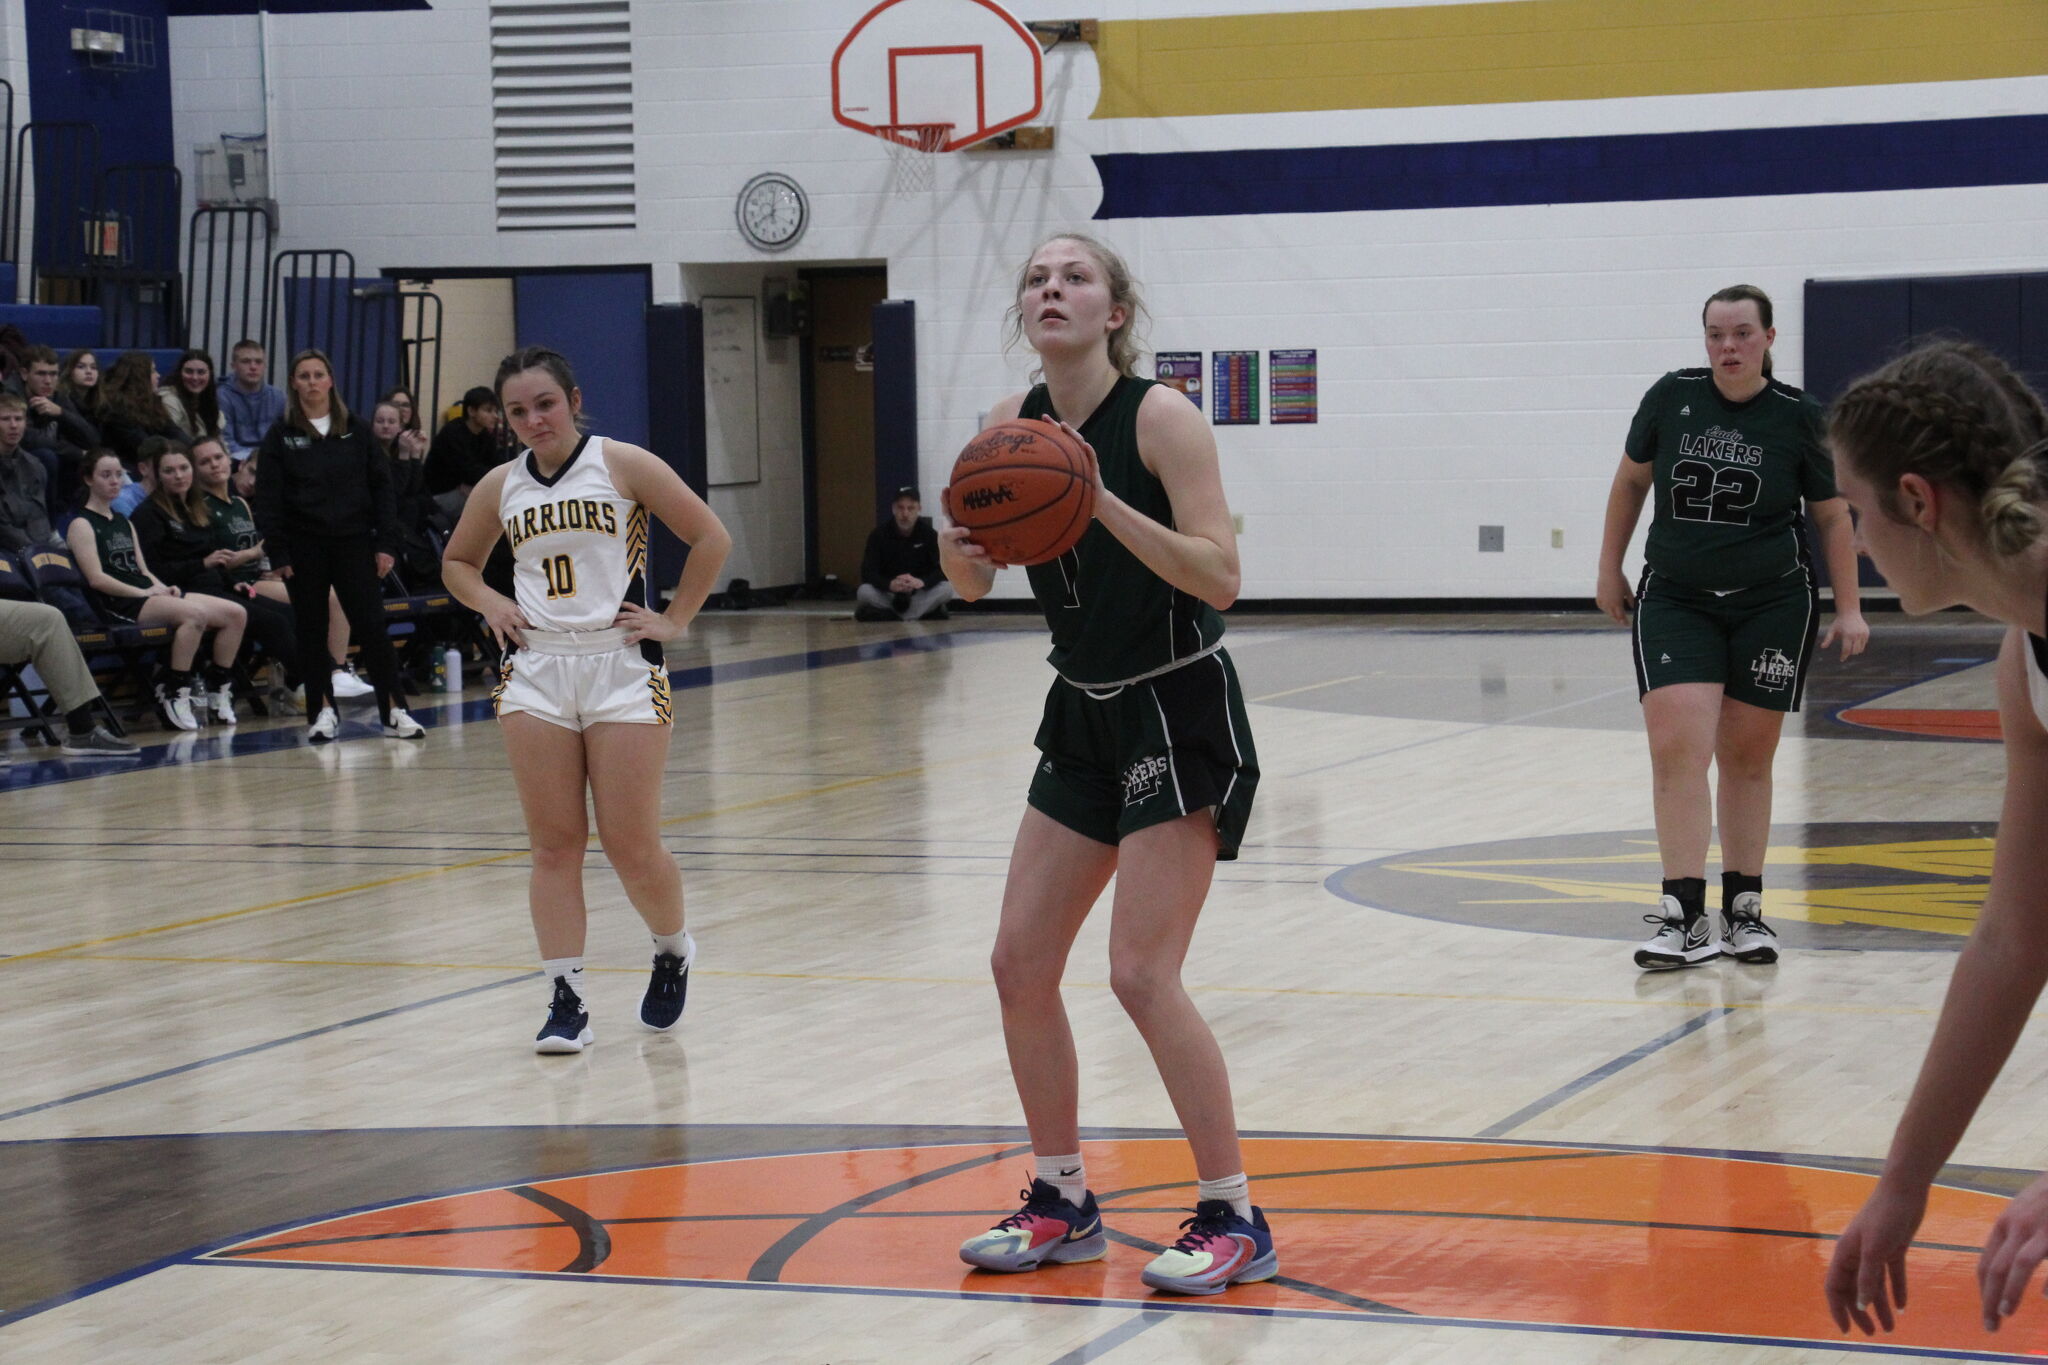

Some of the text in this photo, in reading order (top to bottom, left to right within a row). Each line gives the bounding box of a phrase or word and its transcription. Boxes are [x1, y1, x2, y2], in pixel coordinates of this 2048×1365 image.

[1679, 433, 1763, 467] LAKERS
[1705, 425, 1744, 443] Lady
[1671, 459, 1762, 526] 22
[507, 498, 618, 548] ARRIORS
[541, 553, 577, 601] 10
[1750, 659, 1796, 678] LAKERS
